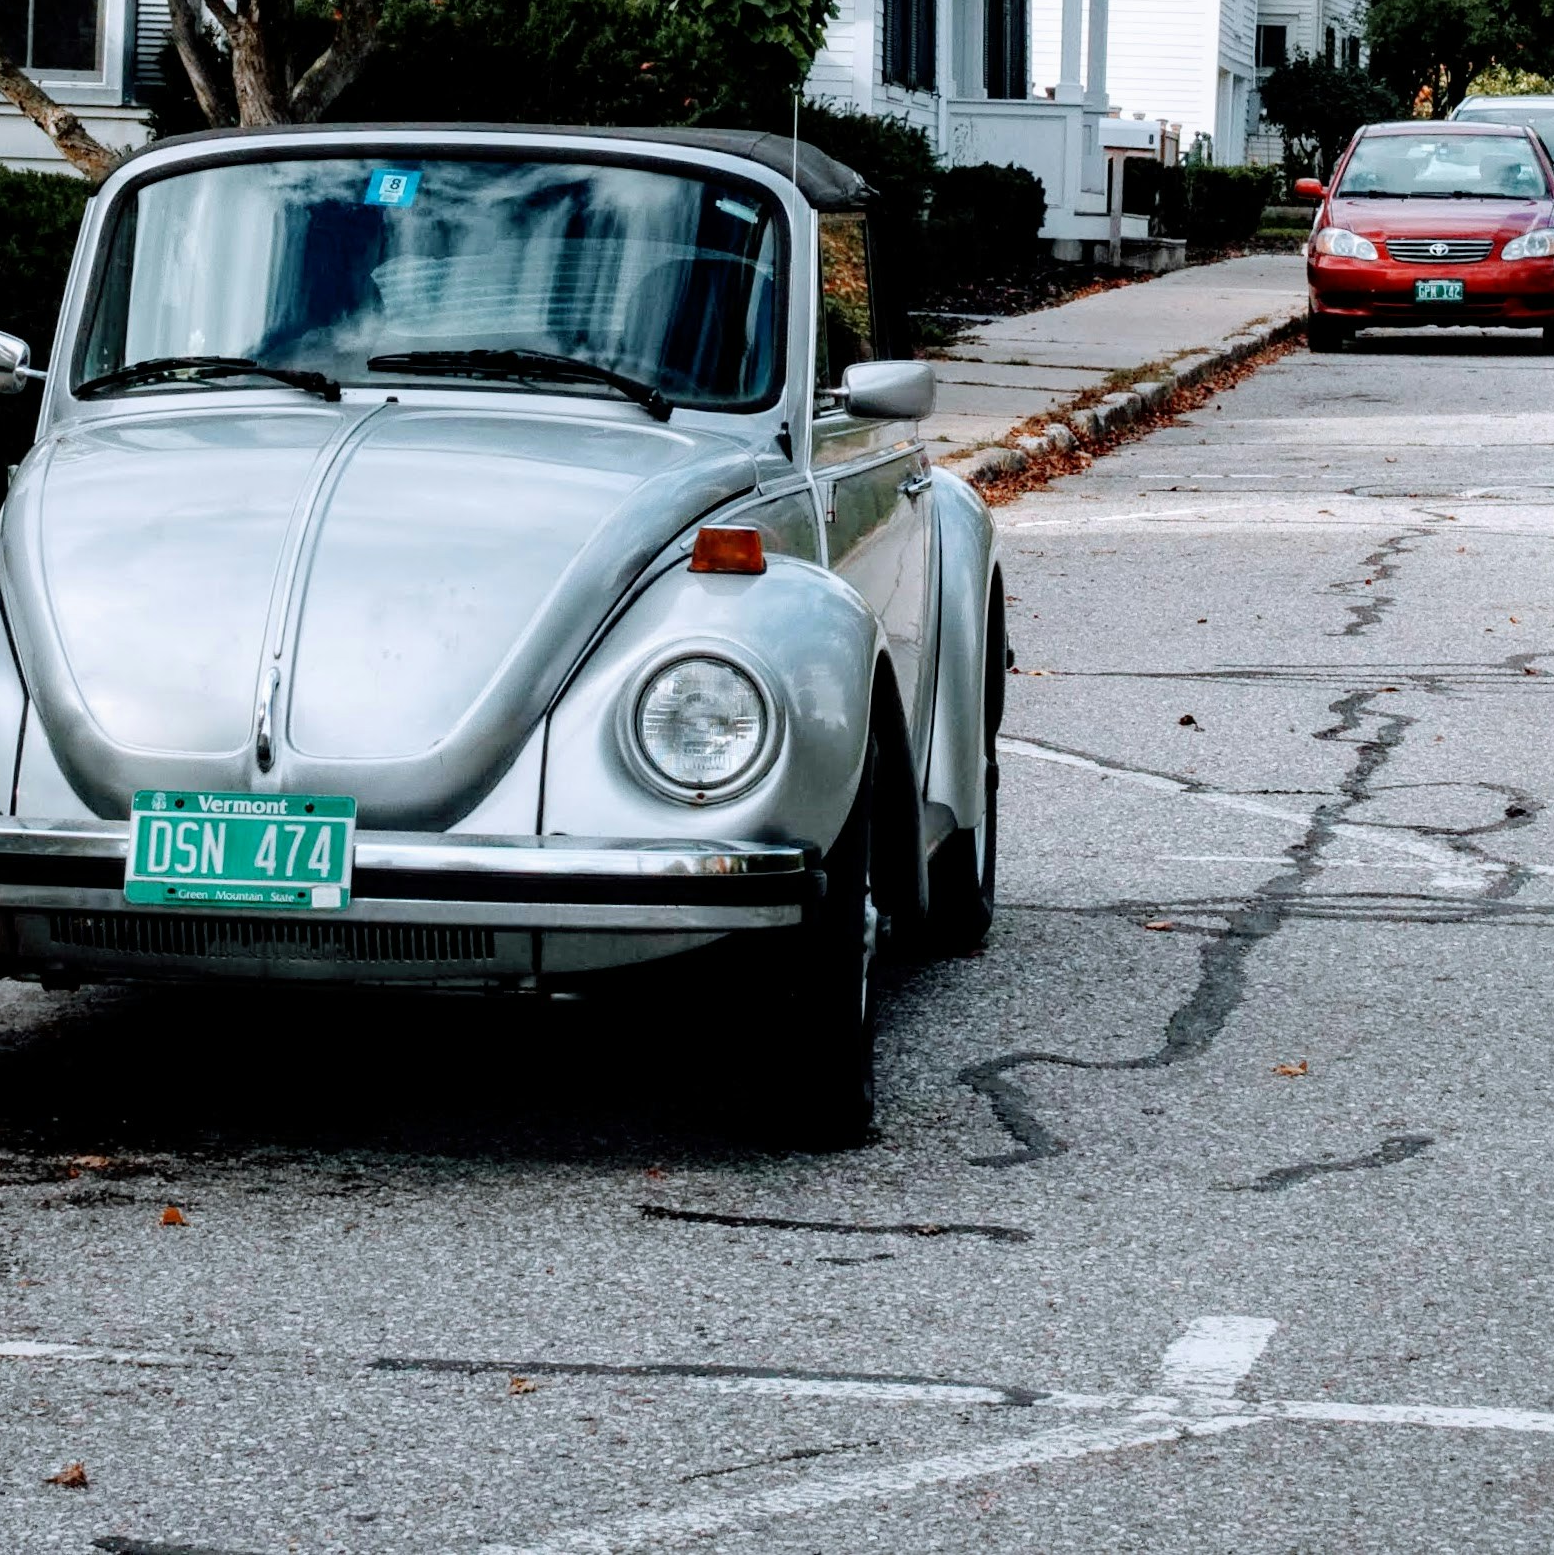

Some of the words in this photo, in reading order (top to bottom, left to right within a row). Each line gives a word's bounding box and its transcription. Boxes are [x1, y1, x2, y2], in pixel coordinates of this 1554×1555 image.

[390, 178, 401, 190] 8
[198, 795, 288, 815] Vermont
[147, 819, 227, 875] DSN
[254, 824, 332, 878] 474
[178, 889, 208, 900] Green
[215, 890, 263, 901] Mountain
[270, 892, 295, 902] State
